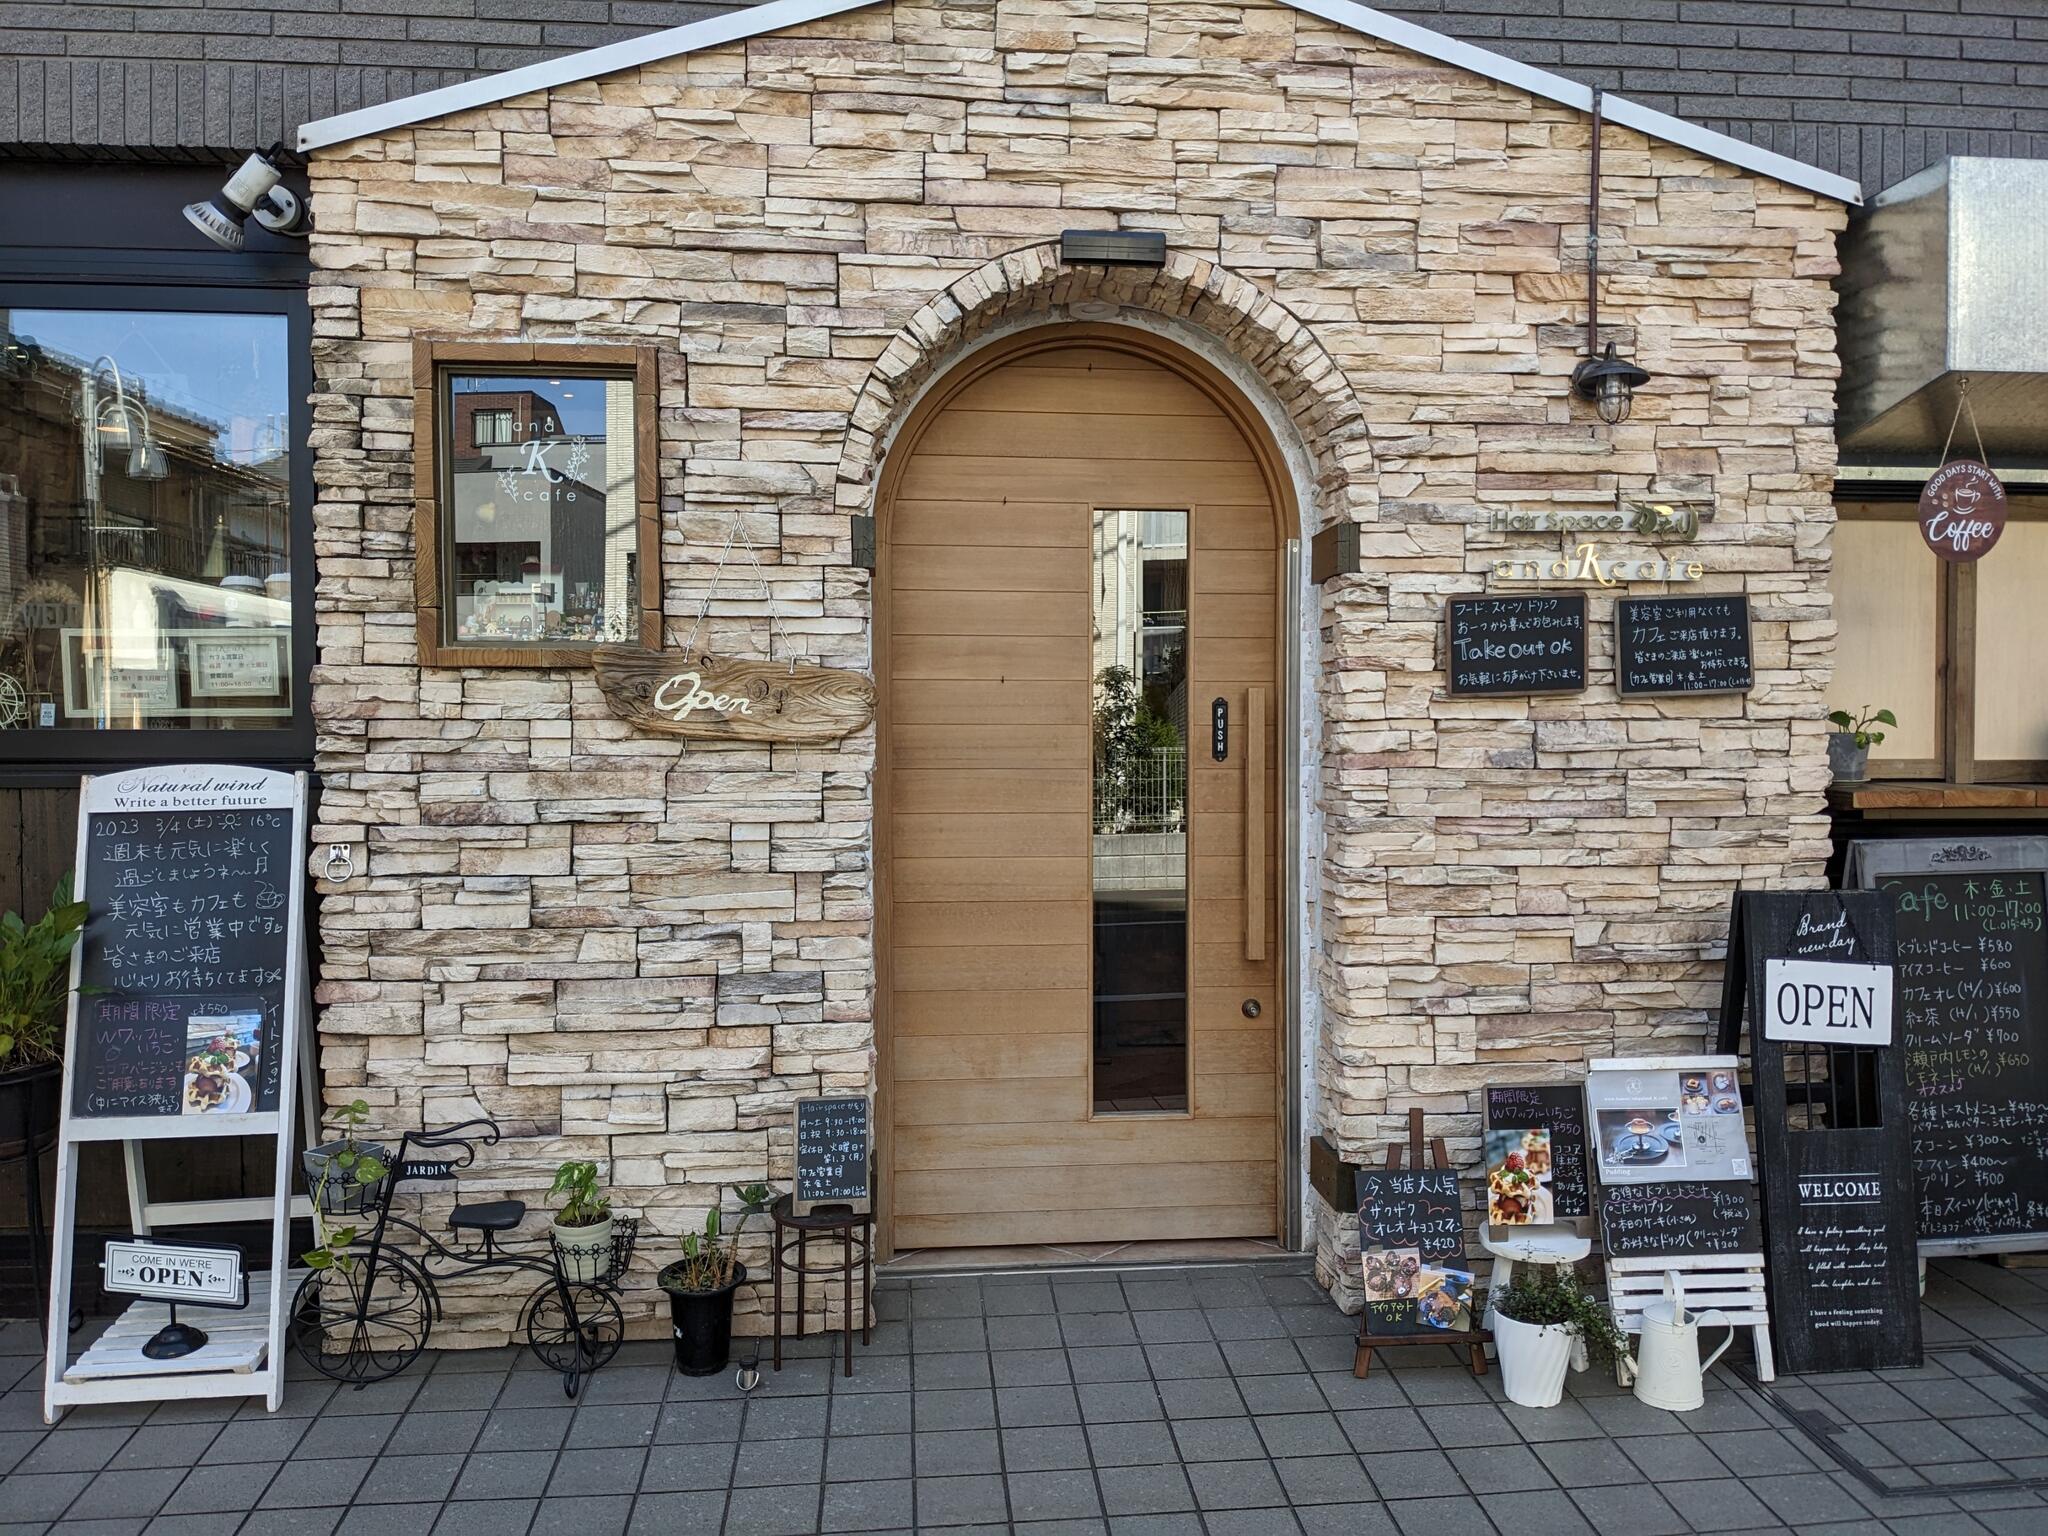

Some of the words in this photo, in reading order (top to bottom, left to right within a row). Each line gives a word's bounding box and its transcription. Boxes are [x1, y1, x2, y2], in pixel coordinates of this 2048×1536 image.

[512, 418, 555, 432] and
[520, 440, 563, 483] K
[1927, 474, 1947, 497] GOOD
[1945, 464, 1966, 478] DAYS
[1967, 464, 1991, 480] START
[1988, 479, 2004, 500] WITH
[523, 488, 577, 501] cafe
[1492, 510, 1540, 531] Hair
[1544, 511, 1624, 535] Space
[1926, 511, 1995, 551] Coffee
[654, 671, 753, 722] Open
[117, 776, 211, 794] Natural
[213, 777, 269, 792] wind
[114, 797, 156, 808] Write
[160, 799, 169, 807] a
[173, 796, 216, 807] better
[221, 795, 268, 806] future
[96, 819, 140, 836] 2023
[155, 815, 182, 839] 3/4
[103, 837, 270, 862] 週末も元気に楽しく
[107, 891, 248, 921] 美容室もカフェも
[1796, 909, 1848, 936] Brand
[1798, 943, 1826, 955] new
[1827, 929, 1856, 955] day
[1978, 937, 2013, 952] ¥580
[103, 943, 222, 968] 皆さまのご来店
[1980, 958, 2012, 972] ¥600
[101, 1001, 181, 1022] 期間限定
[1777, 982, 1876, 1029] OPEN
[1906, 1008, 1941, 1029] 紅茶
[1553, 1121, 1581, 1135] ¥550
[406, 1164, 447, 1176] JARDIN
[1975, 1171, 2004, 1187] ¥500
[1798, 1182, 1881, 1198] WELCOME
[1369, 1200, 1415, 1220] ザクザク
[1423, 1237, 1456, 1251] ¥420
[132, 1254, 163, 1265] COME
[165, 1258, 176, 1266] IN
[179, 1258, 212, 1269] WE'RE
[139, 1266, 205, 1287] OPEN
[1833, 1308, 1853, 1316] feeling
[1854, 1307, 1883, 1315] something
[1815, 1321, 1829, 1329] good
[1842, 1320, 1862, 1328] happen
